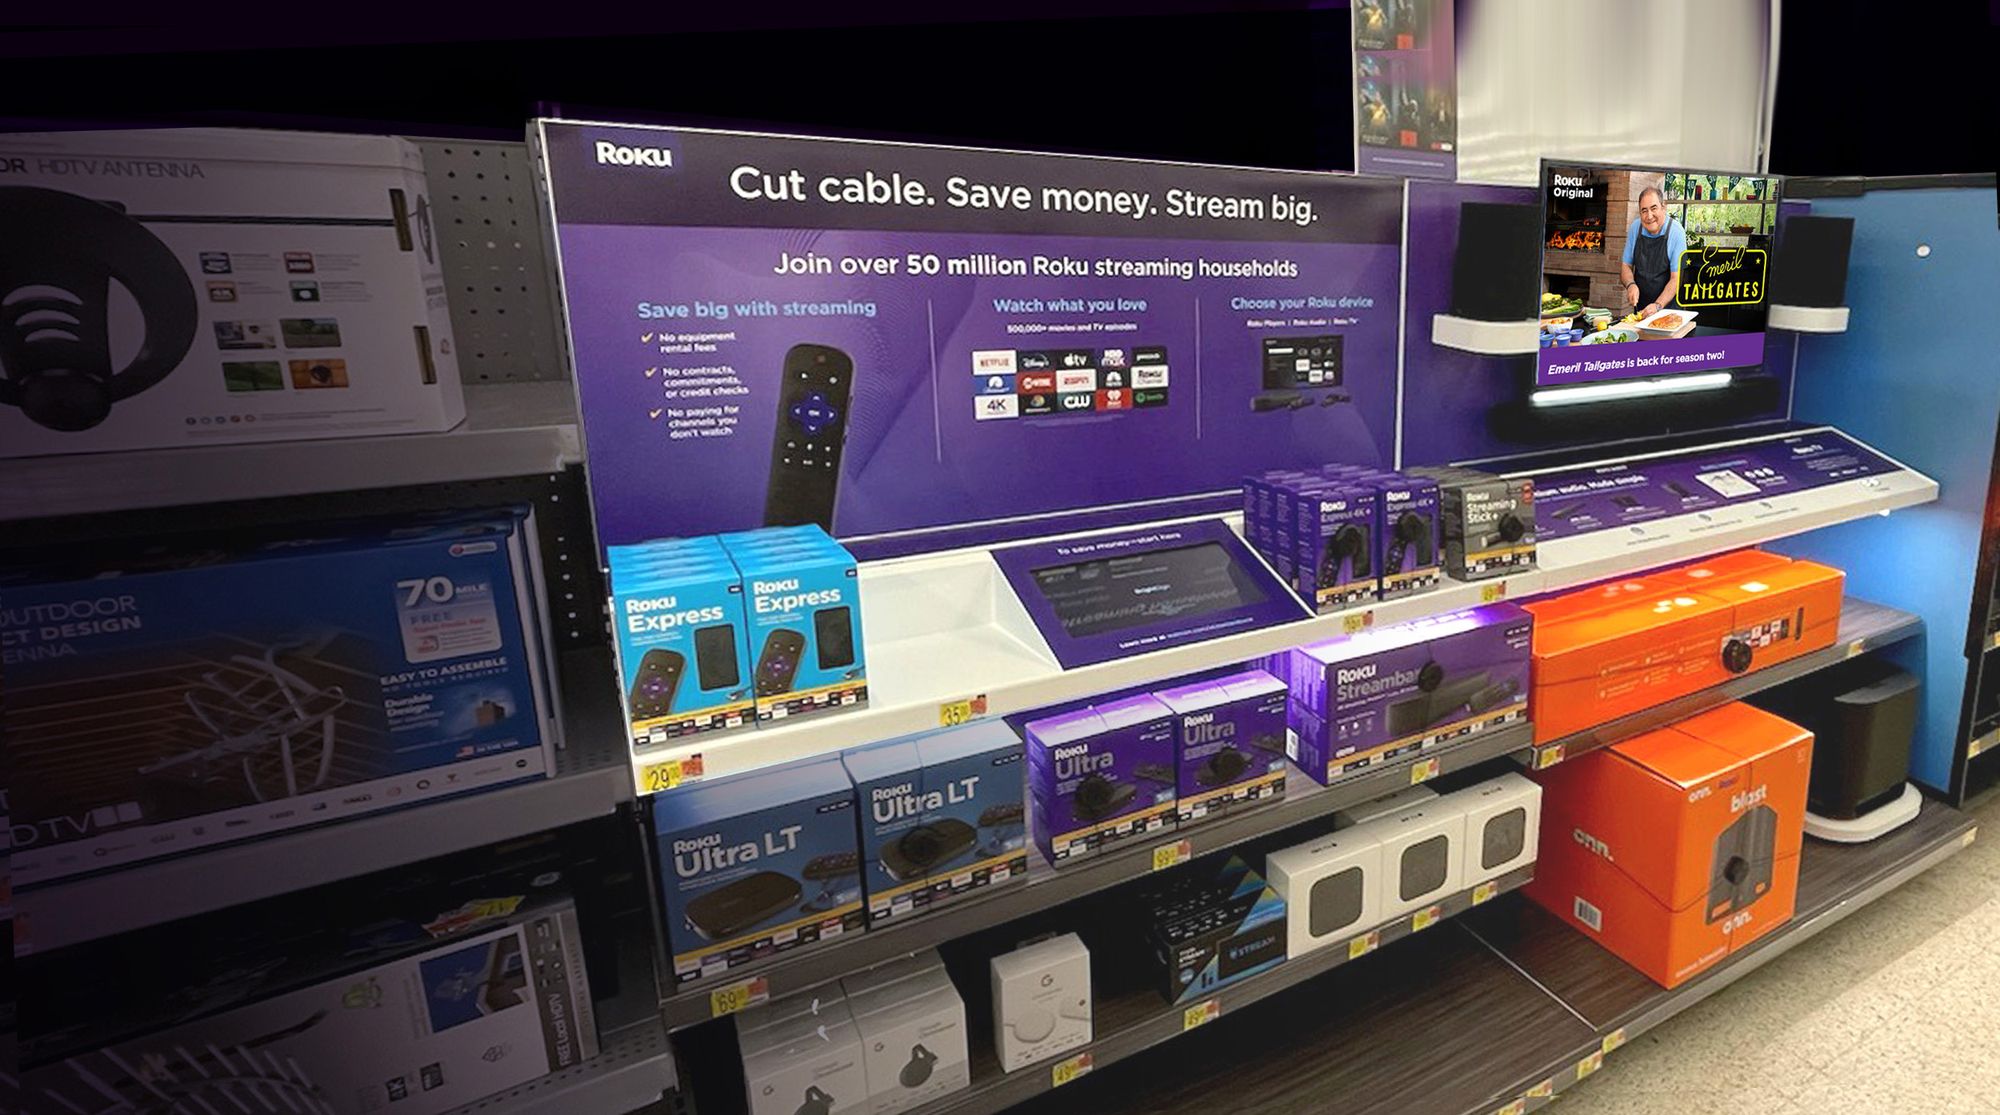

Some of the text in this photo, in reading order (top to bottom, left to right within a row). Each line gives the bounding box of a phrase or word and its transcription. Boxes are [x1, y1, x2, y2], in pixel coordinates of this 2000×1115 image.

[595, 141, 672, 167] Roku
[102, 160, 205, 179] ANTENNA
[1554, 174, 1582, 187] Roku
[730, 166, 1318, 225] Cut cable. Save money. Stream big.
[1554, 187, 1593, 199] Original
[774, 253, 1298, 280] Join over 50 million Roku streaming households
[1698, 241, 1746, 291] Emeril
[1684, 281, 1758, 300] TAILGATES
[637, 300, 877, 319] Save big with streaming
[993, 298, 1147, 313] Watch what you love
[1231, 296, 1374, 312] Choose your Roku device
[659, 332, 736, 343] No equipment
[660, 343, 692, 353] rental
[663, 367, 680, 376] No
[1548, 350, 1725, 376] Emeril Tailgates is back for season two!
[665, 385, 749, 398] or credit checks
[667, 405, 740, 417] No paying for
[987, 398, 1006, 411] 4K
[717, 417, 738, 426] you
[700, 427, 733, 437] watch
[1386, 491, 1410, 502] Roku
[1467, 499, 1517, 512] Streaming
[1320, 501, 1347, 513] Roku
[397, 576, 453, 607] 70
[753, 579, 798, 595] Roku
[625, 596, 677, 614] Roku
[755, 588, 841, 613] Express
[40, 615, 142, 641] DESIGN
[628, 605, 724, 633] Express
[380, 657, 507, 686] EASY TO ASSEMBLE
[1337, 664, 1377, 685] Roku
[1337, 667, 1421, 702] Streambar
[945, 707, 961, 727] 35
[1184, 713, 1213, 728] Roku
[1184, 721, 1235, 746] Ultra
[1054, 744, 1088, 760] Roku
[1055, 752, 1113, 779] Ultra
[650, 768, 670, 791] 29
[872, 783, 912, 801] Roku
[872, 790, 943, 825] Ultra
[948, 776, 980, 804] LT
[1731, 784, 1767, 812] blast
[673, 833, 721, 855] Roku
[674, 825, 802, 878] Ultra LT
[720, 991, 737, 1013] 69
